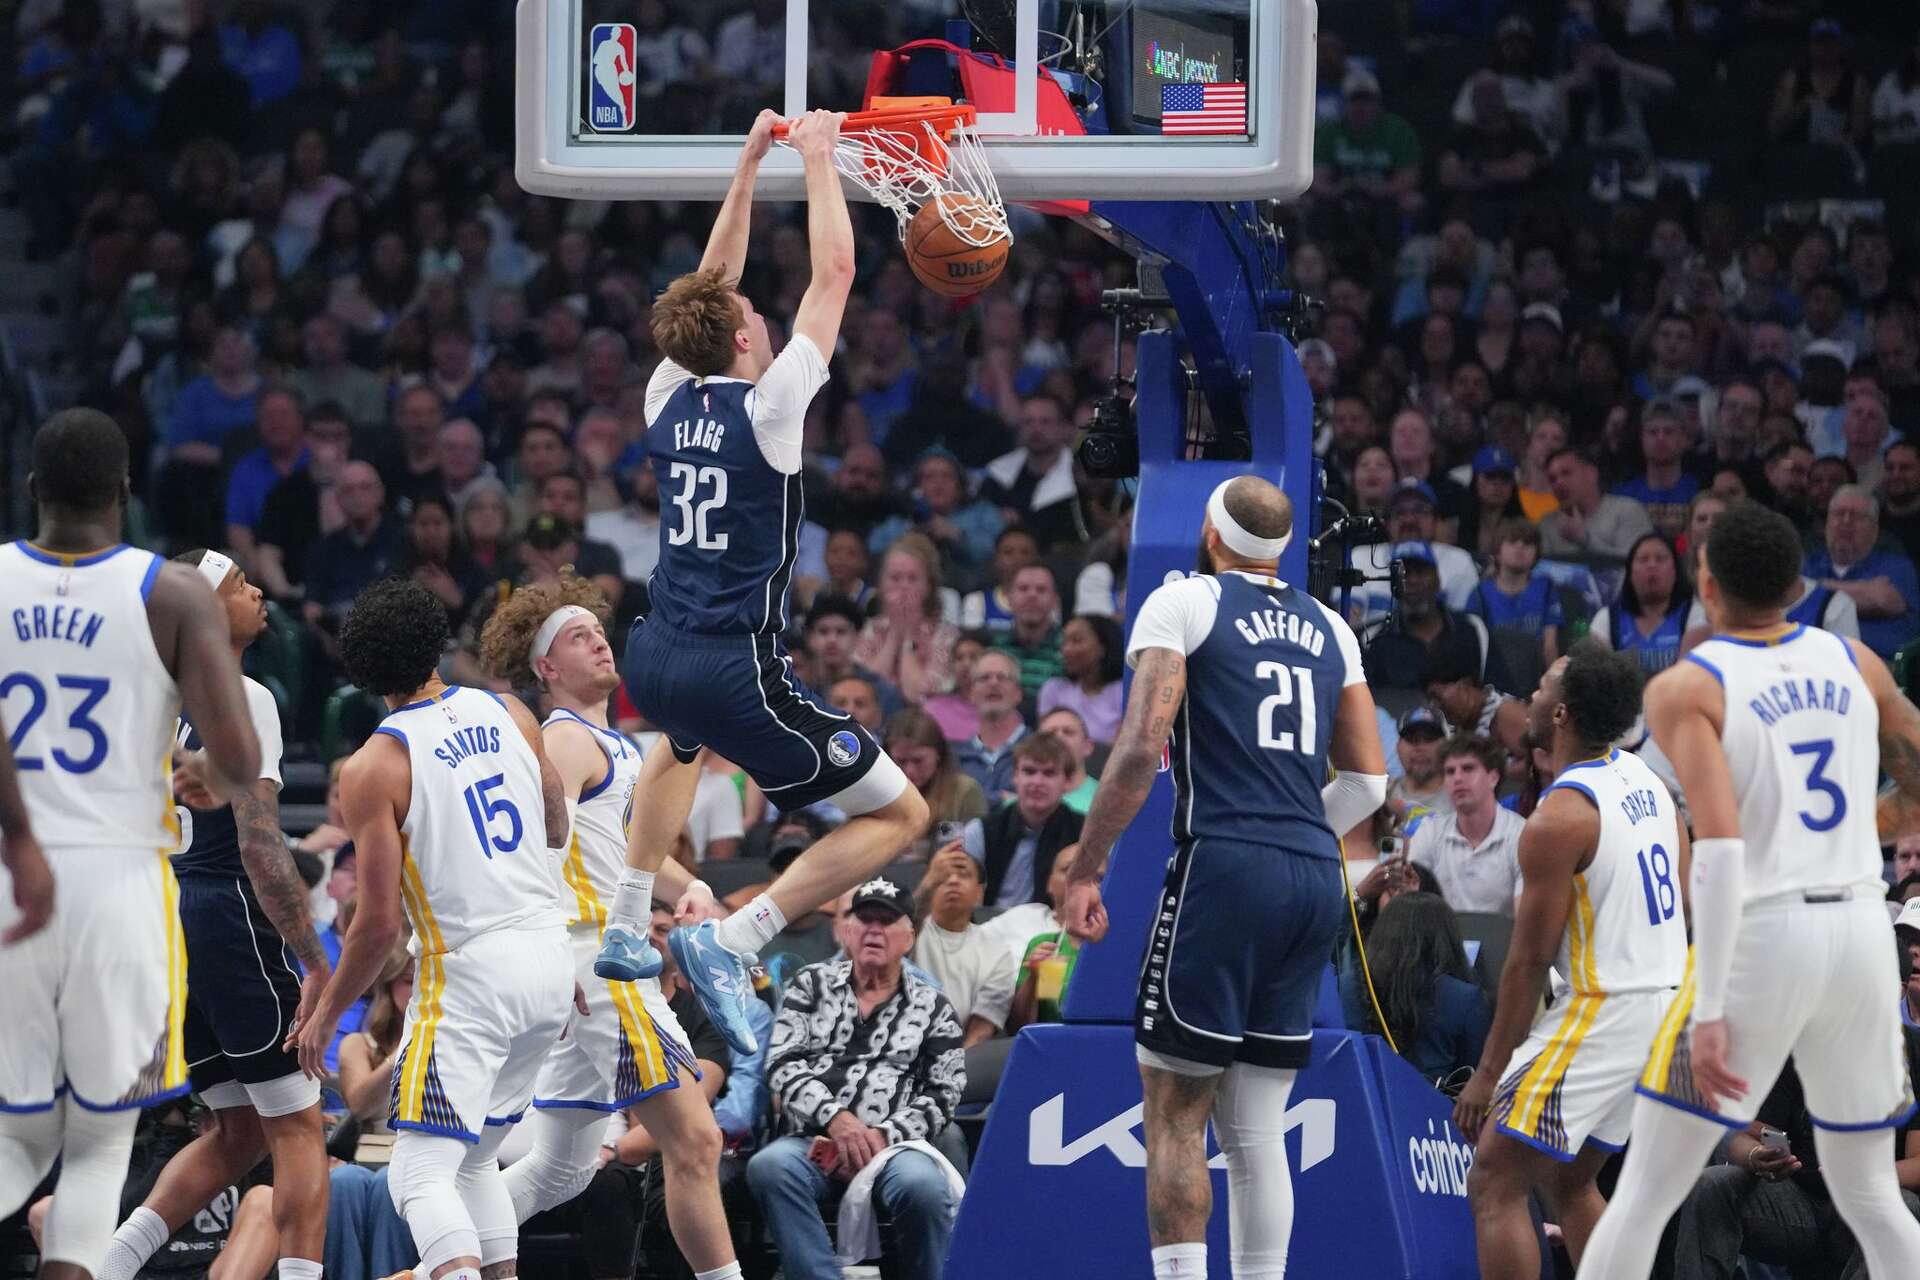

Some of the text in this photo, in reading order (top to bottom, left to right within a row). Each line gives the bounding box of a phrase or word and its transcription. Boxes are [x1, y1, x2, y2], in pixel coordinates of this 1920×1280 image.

[596, 106, 618, 123] NBA
[948, 253, 1006, 278] Wilson
[674, 418, 725, 453] FLAGG
[668, 461, 729, 550] 32
[13, 605, 104, 648] GREEN
[1234, 609, 1325, 657] GAFFORD
[0, 671, 110, 774] 23
[1255, 660, 1317, 755] 21
[1750, 681, 1851, 726] RICHARD
[434, 725, 501, 769] SANTOS
[1621, 789, 1658, 826] CRYER
[1789, 738, 1847, 832] 3
[463, 772, 523, 860] 15
[1637, 843, 1675, 926] 18
